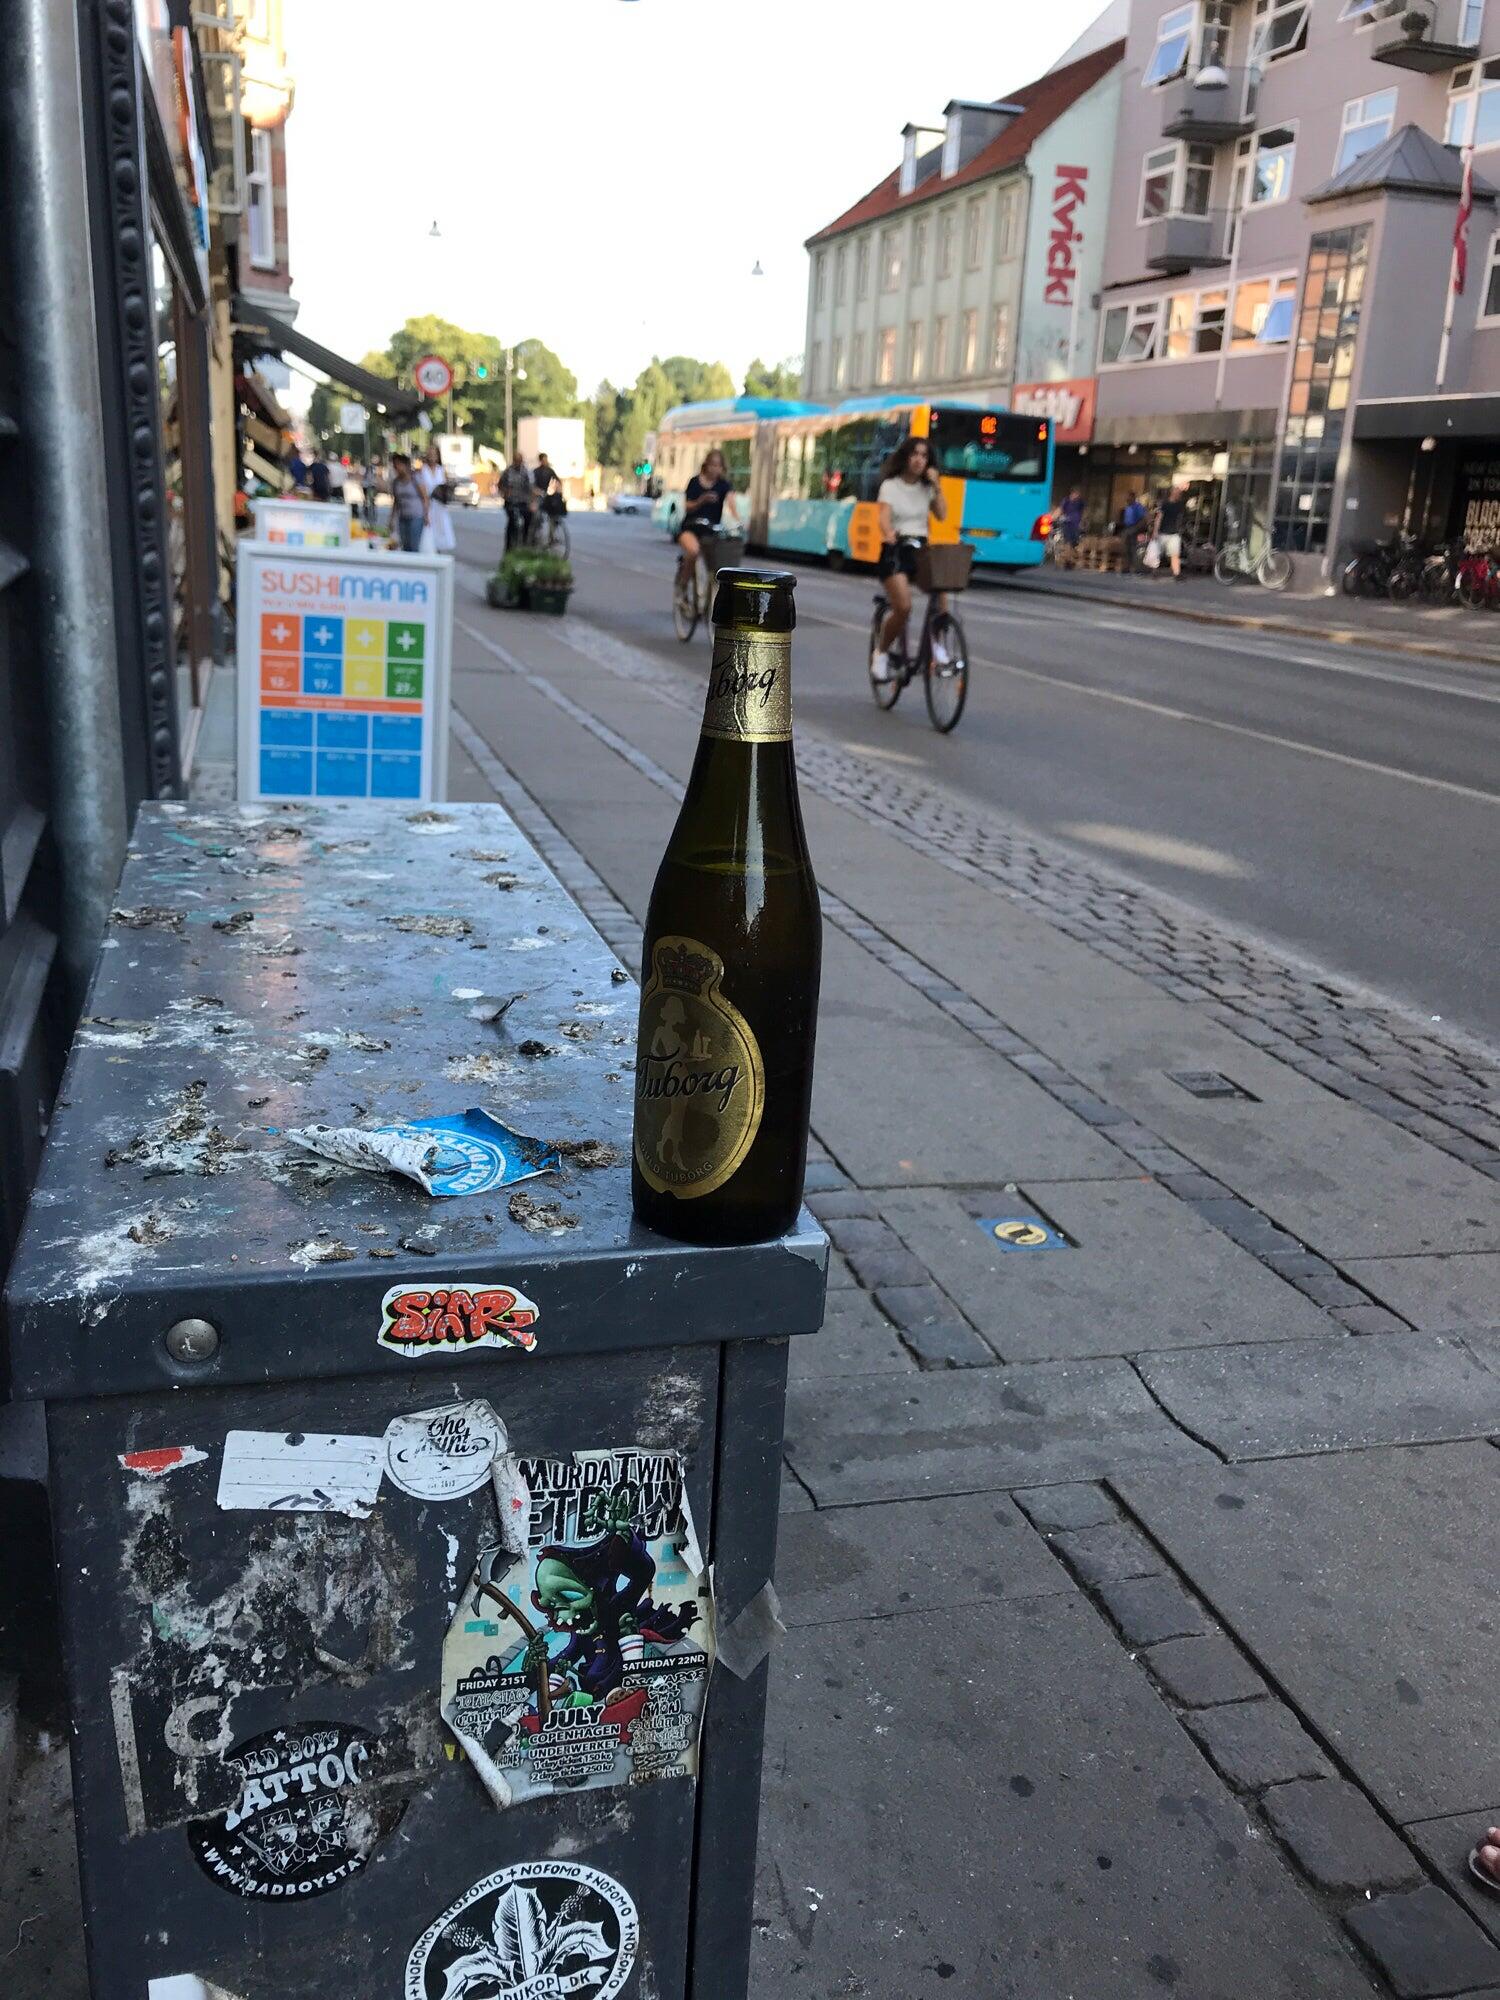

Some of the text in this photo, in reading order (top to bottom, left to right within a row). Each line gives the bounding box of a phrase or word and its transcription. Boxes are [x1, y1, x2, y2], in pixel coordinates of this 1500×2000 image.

[423, 367, 444, 385] 40
[636, 1047, 744, 1113] Tuborg
[665, 1161, 714, 1183] TUBORG
[622, 1654, 706, 1672] SATURDAY 22ND
[459, 1675, 526, 1691] FRIDAY 21ST
[543, 1704, 605, 1731] JULY
[529, 1723, 620, 1745] COPENHAGEN
[230, 1729, 340, 1777] BAD BOYS
[529, 1738, 620, 1759] UNDERWERKET
[409, 1863, 637, 1989] NOFOMO NOFOMO NOFOMO NOFOMO NOFOMO
